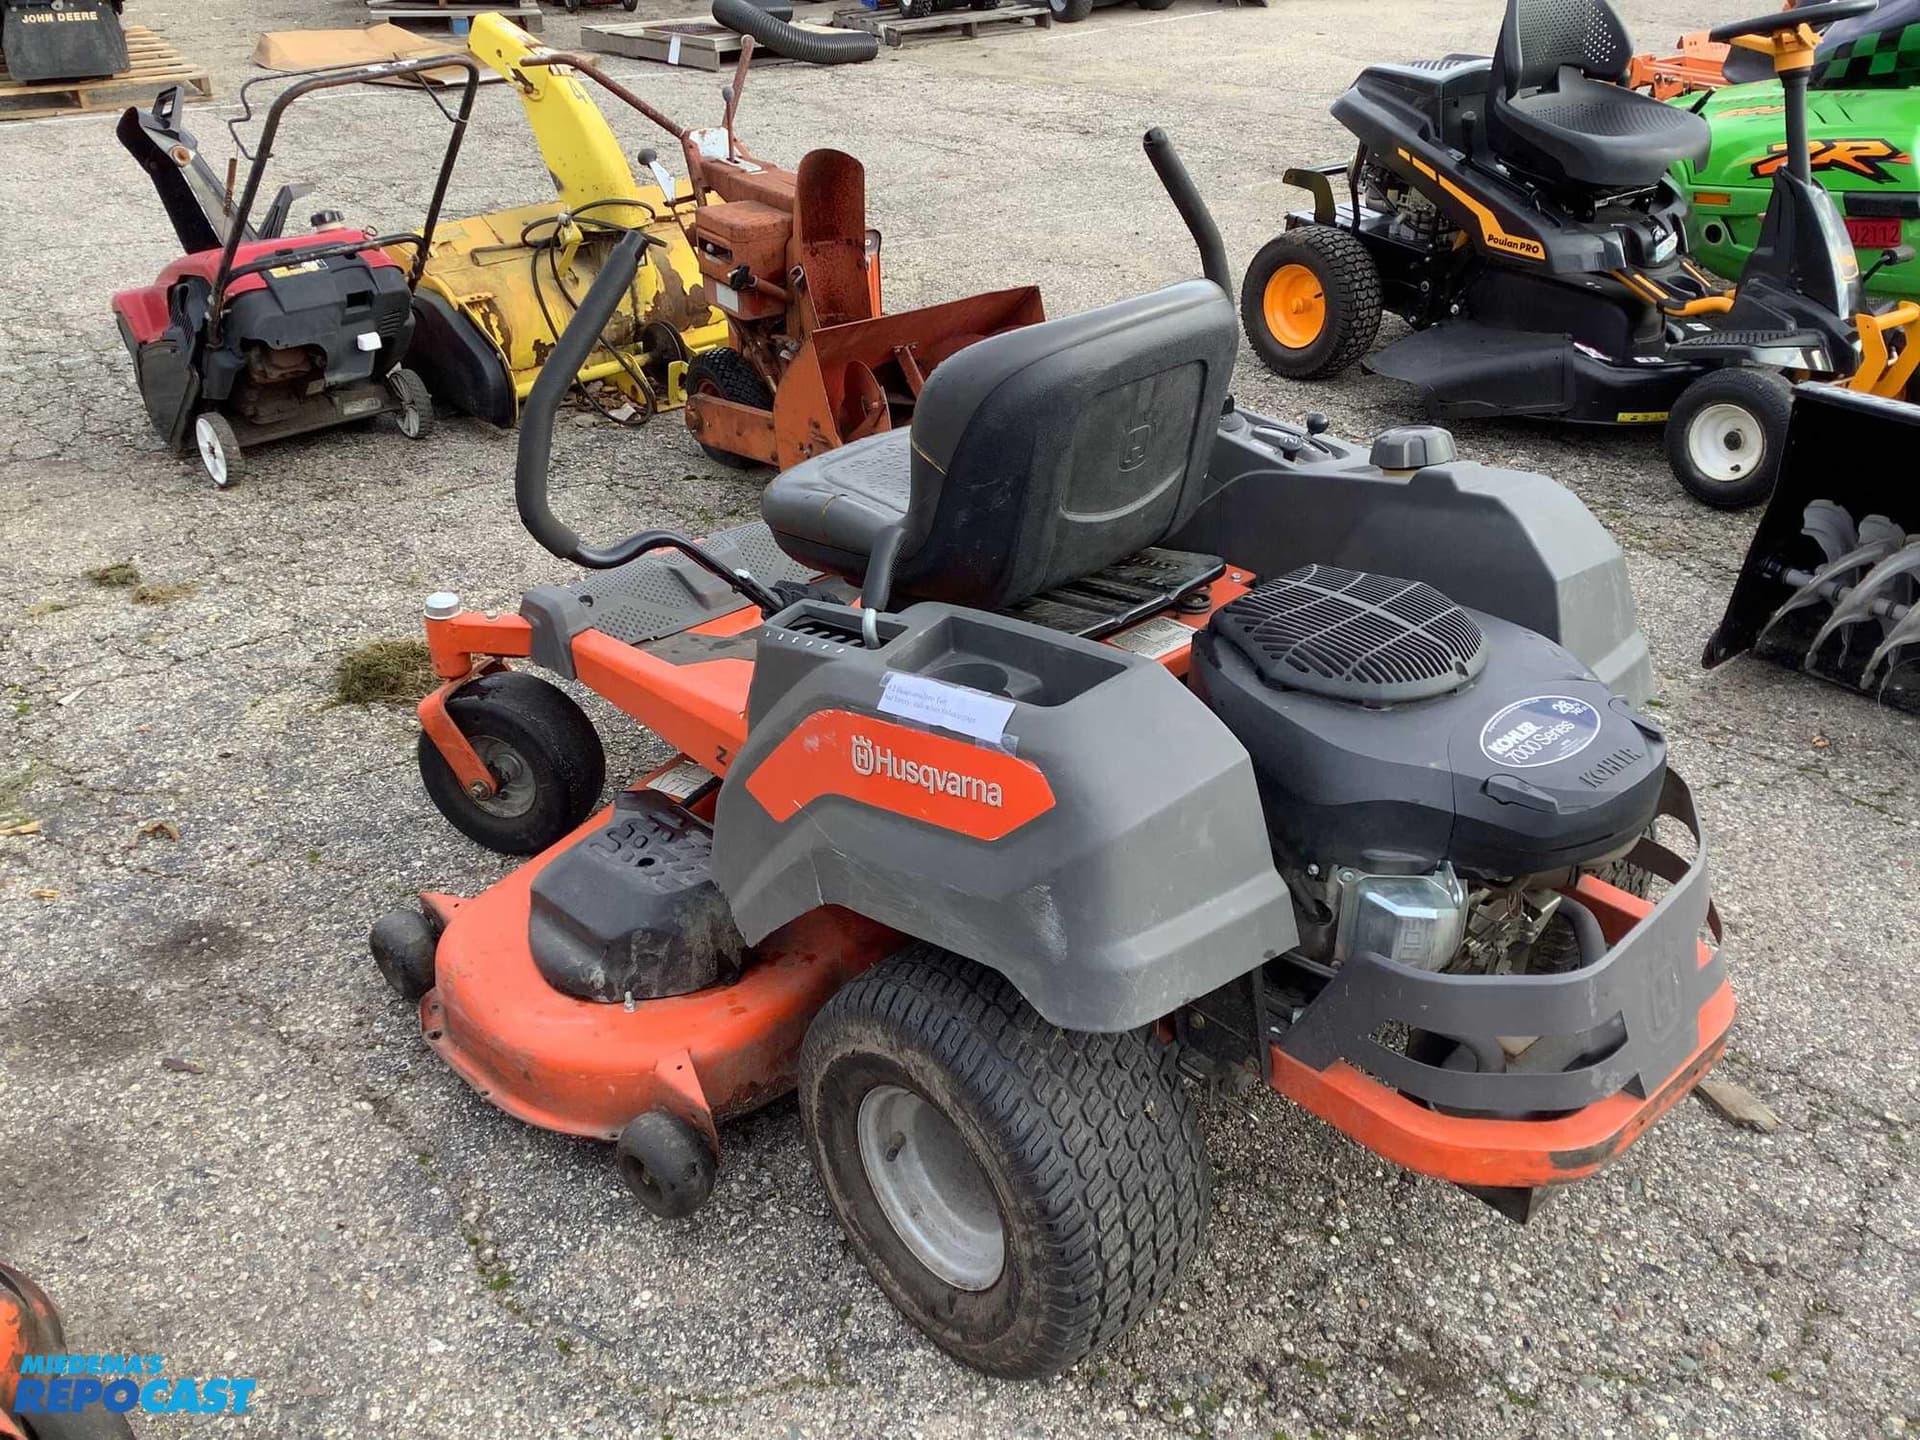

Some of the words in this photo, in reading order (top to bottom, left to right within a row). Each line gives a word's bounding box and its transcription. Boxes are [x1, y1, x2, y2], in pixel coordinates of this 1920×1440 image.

[22, 13, 54, 24] JOHN
[57, 11, 98, 22] DEERE
[1487, 234, 1518, 250] Poulan
[1520, 242, 1540, 254] PRO
[1487, 721, 1543, 755] KOHLER
[1504, 740, 1542, 764] 7000
[1533, 720, 1576, 745] Series
[875, 745, 1003, 807] Husqvarna
